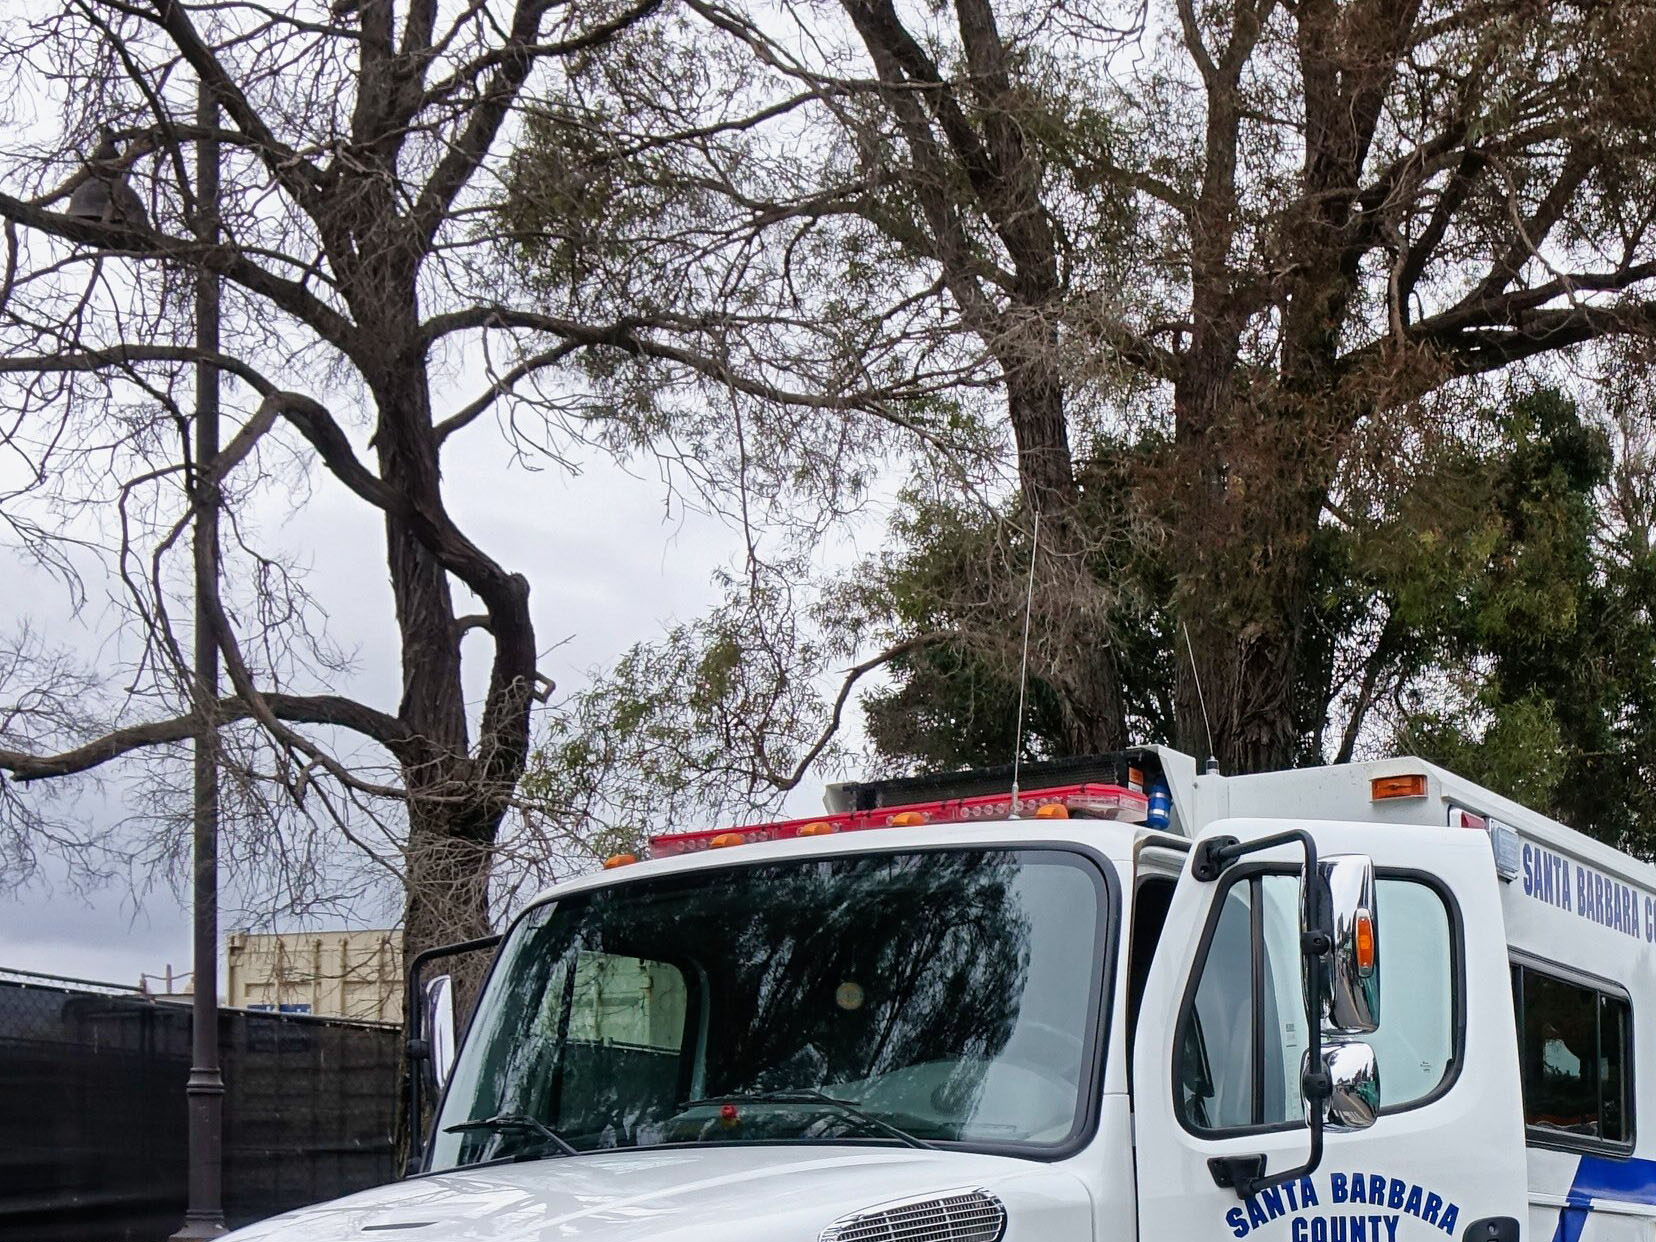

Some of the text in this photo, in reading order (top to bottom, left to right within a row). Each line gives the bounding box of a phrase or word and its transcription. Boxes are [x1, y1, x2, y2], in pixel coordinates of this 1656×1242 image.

[1522, 843, 1572, 912] SANTA
[1577, 866, 1640, 939] BARBARA
[1226, 1173, 1460, 1238] SANTA BARBARA
